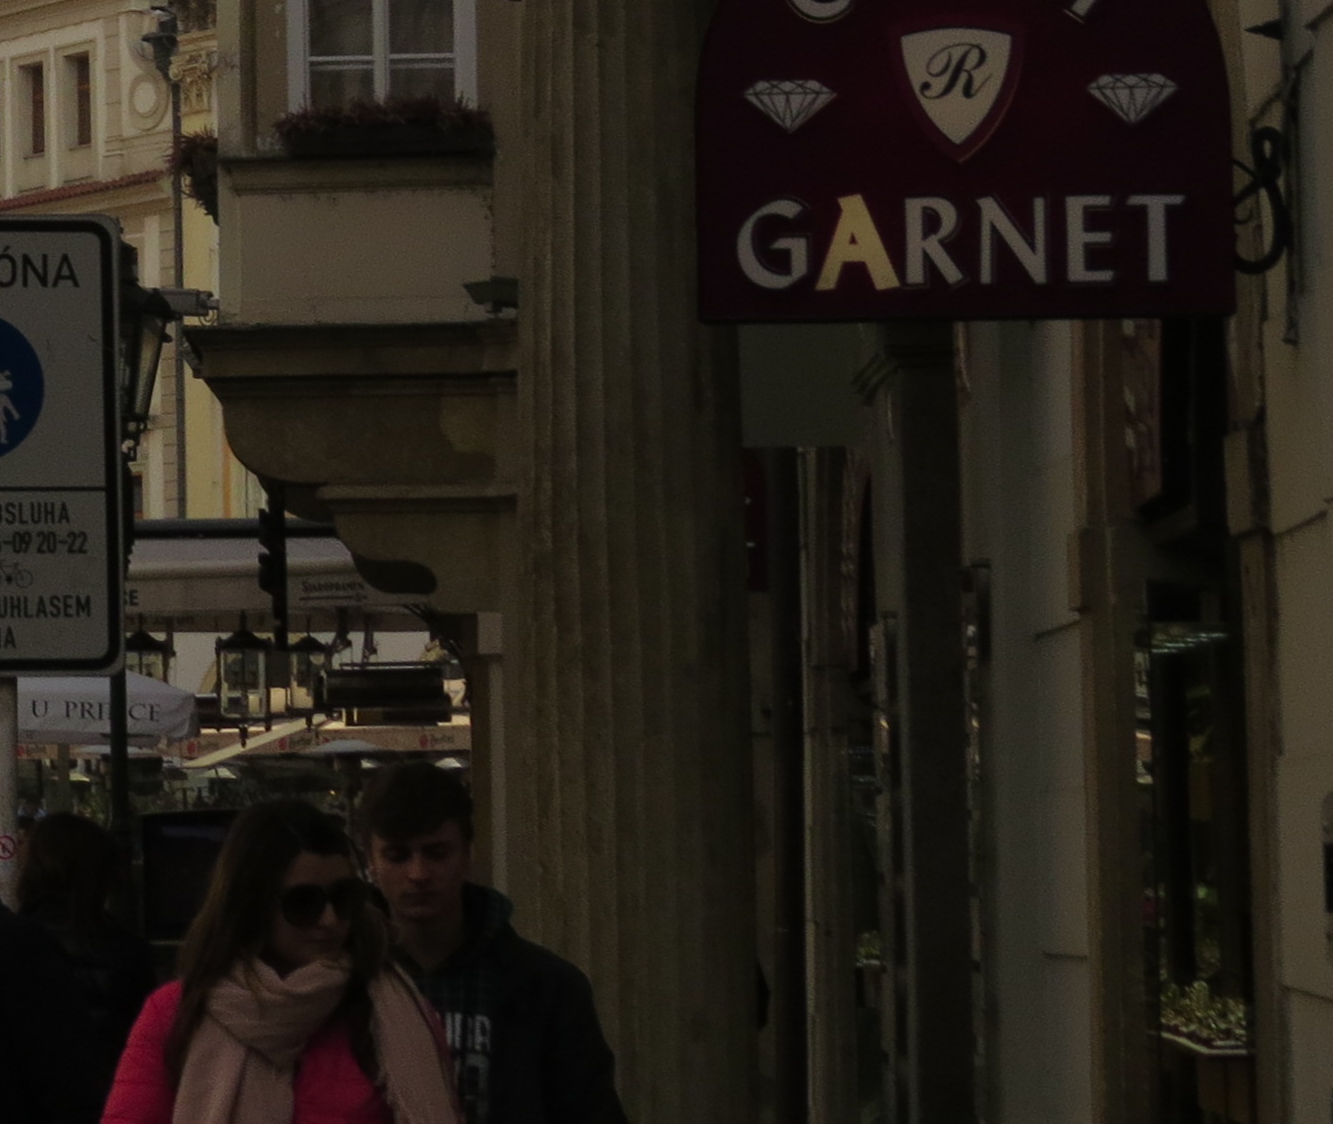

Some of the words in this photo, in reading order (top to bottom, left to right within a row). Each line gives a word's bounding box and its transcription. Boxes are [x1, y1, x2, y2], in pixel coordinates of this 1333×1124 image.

[736, 194, 1186, 292] GARNET
[35, 531, 88, 555] 20-22
[31, 700, 49, 719] U
[64, 700, 161, 723] PRICE
